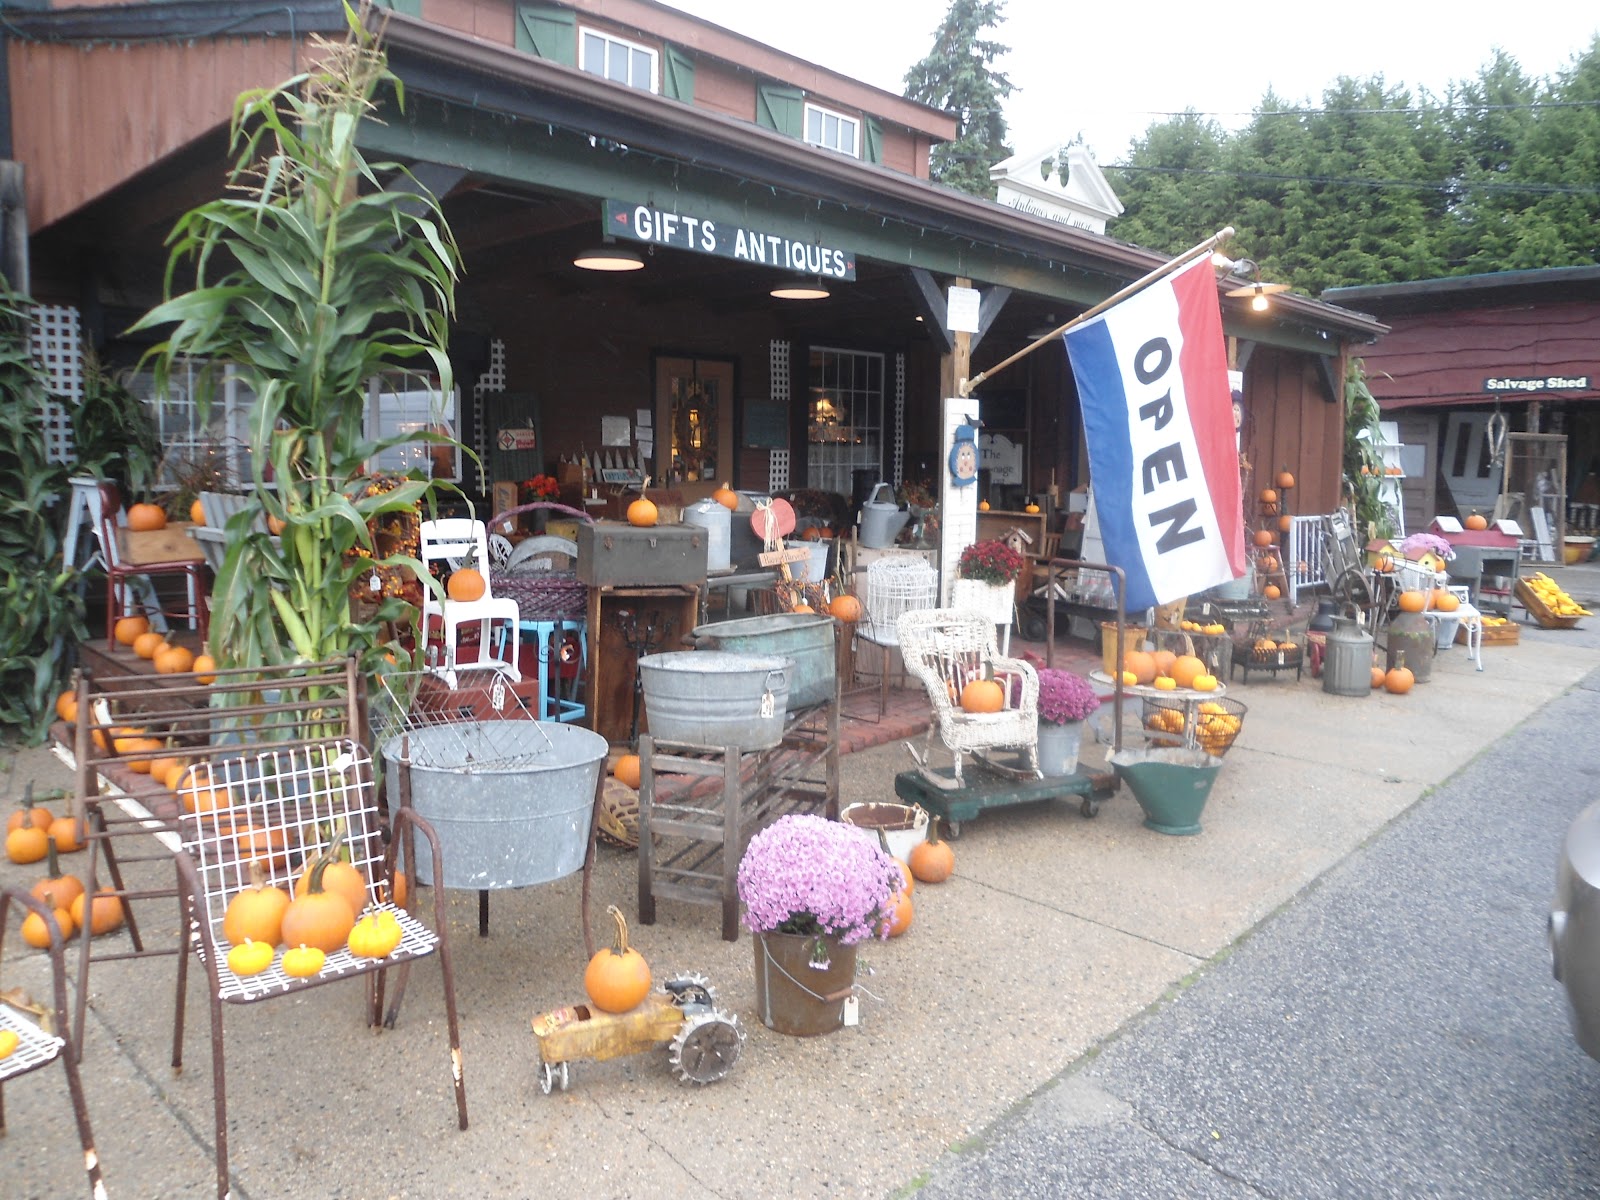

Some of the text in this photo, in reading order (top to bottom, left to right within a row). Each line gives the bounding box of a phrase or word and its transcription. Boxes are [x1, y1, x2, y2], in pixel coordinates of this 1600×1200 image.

[634, 205, 846, 277] GIFTS ANTIQUES
[1487, 377, 1587, 391] Salvage Shed
[981, 448, 1001, 459] The
[1134, 336, 1206, 556] OPEN
